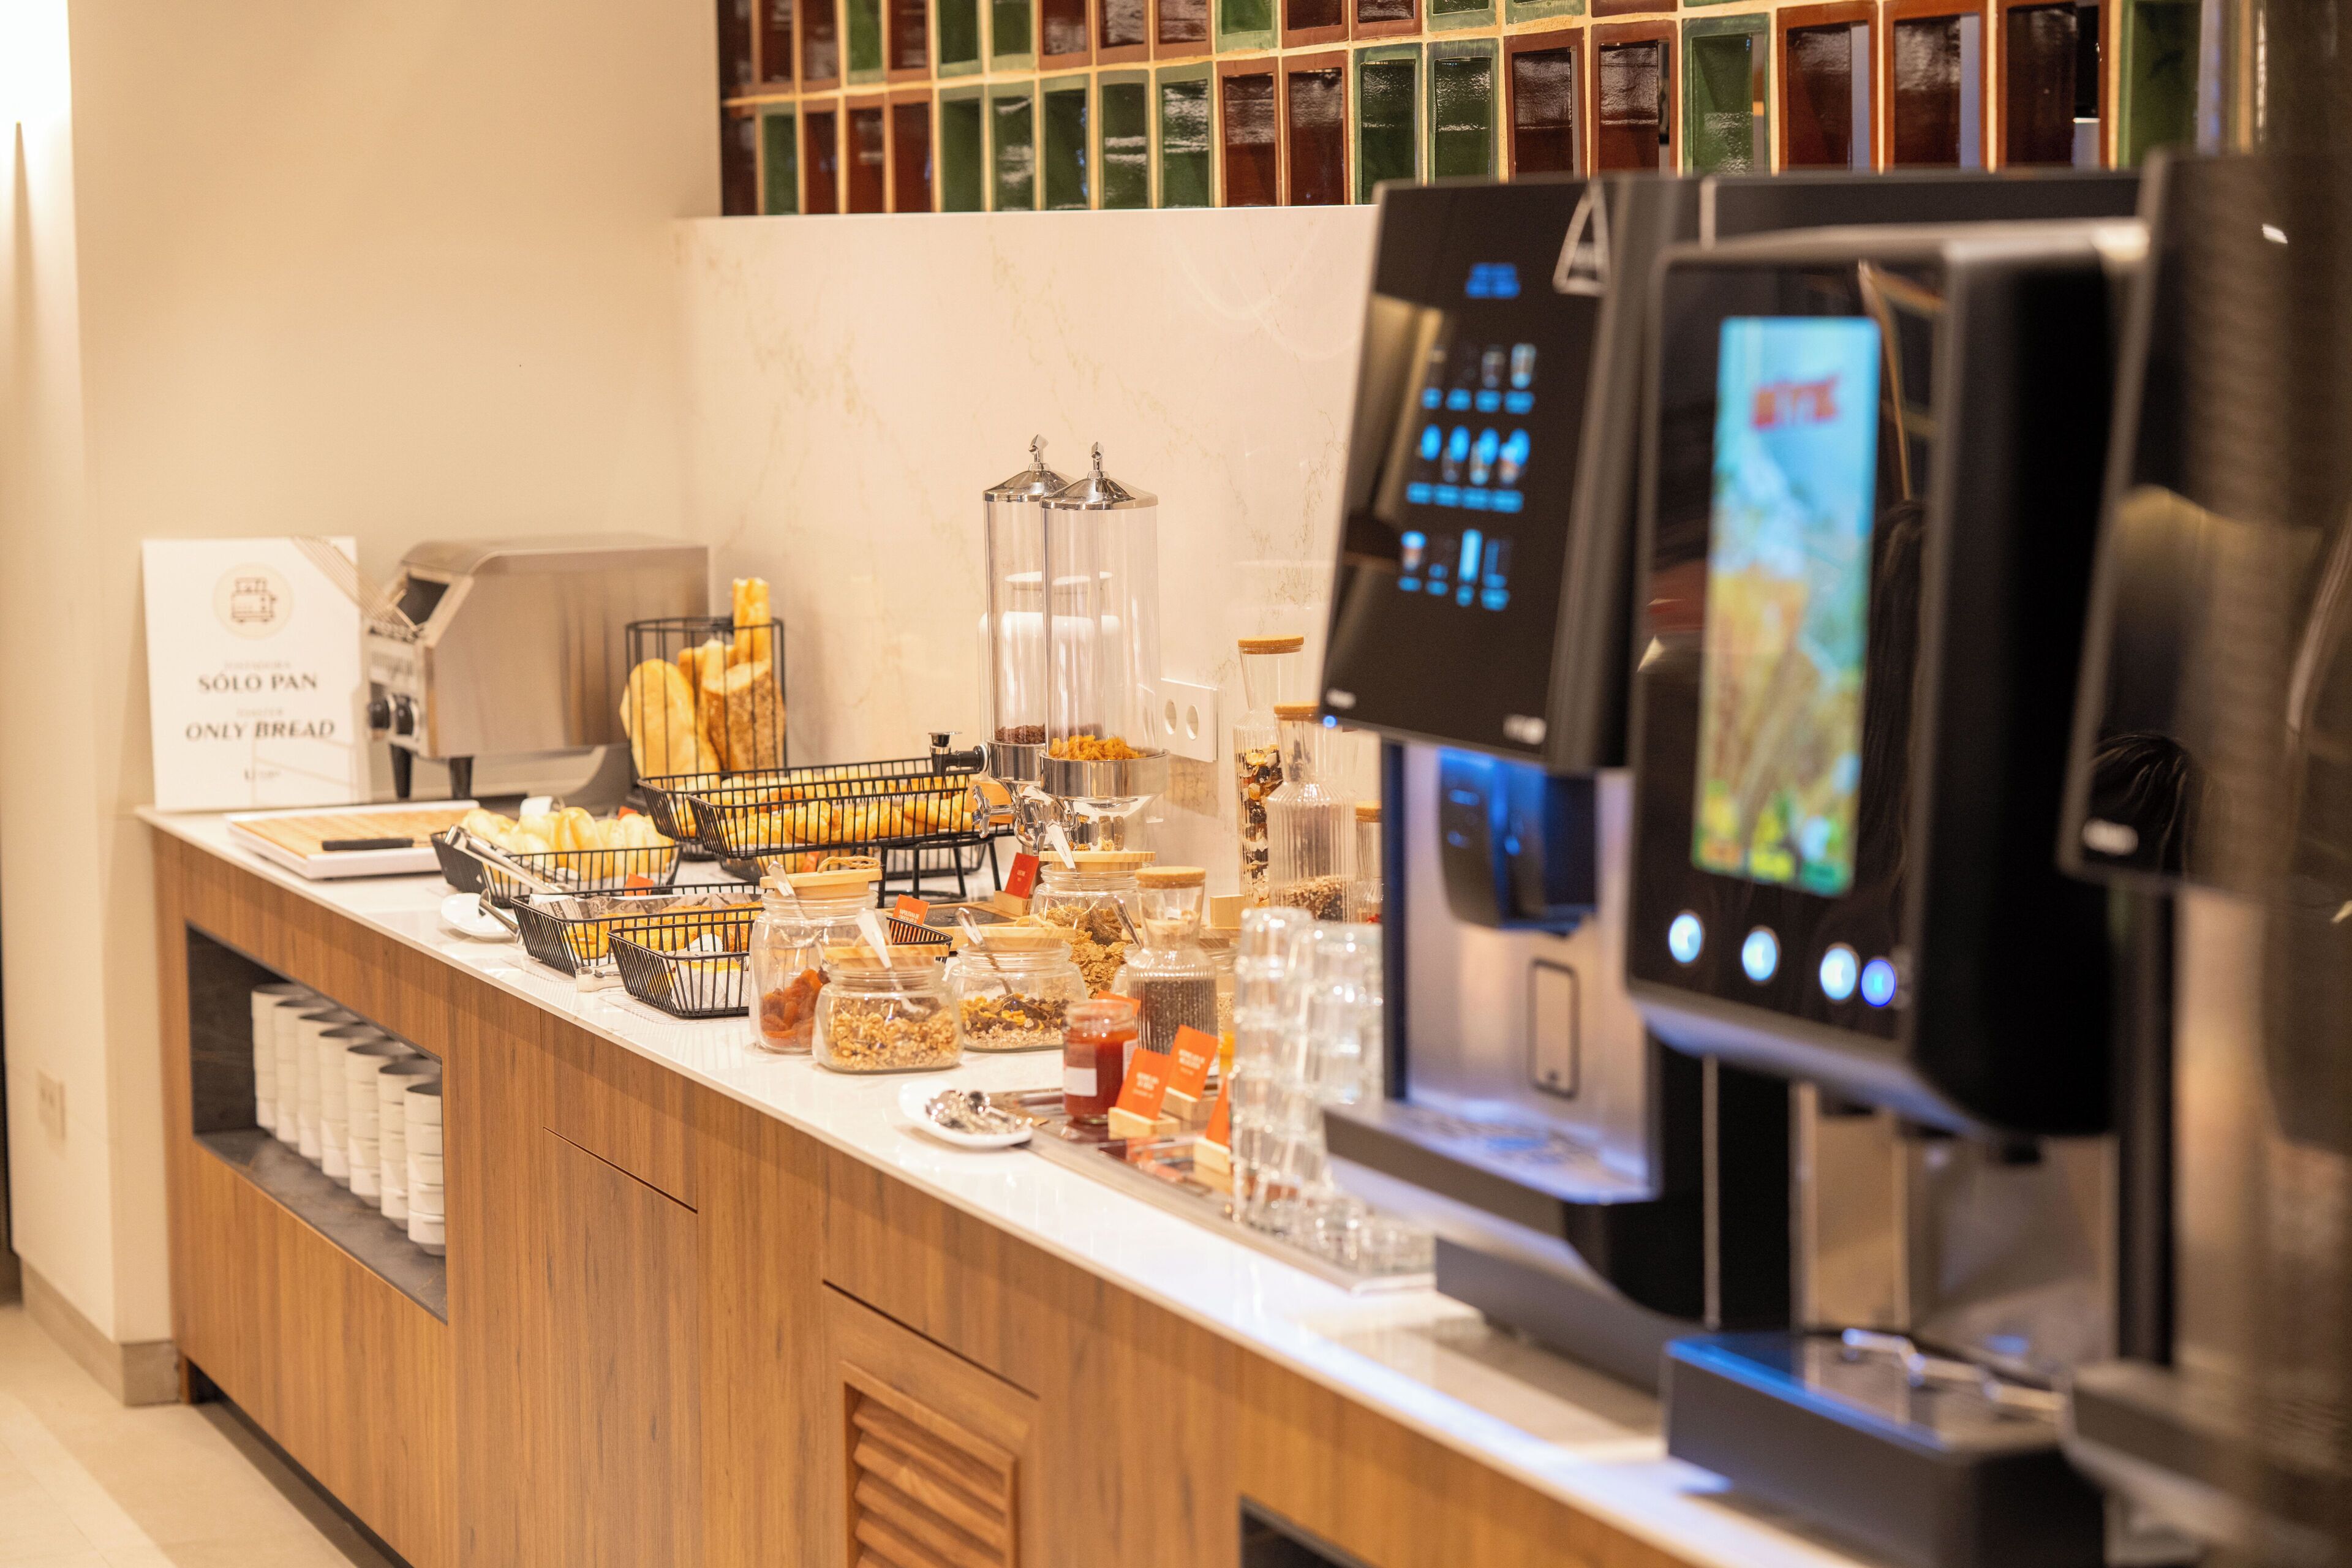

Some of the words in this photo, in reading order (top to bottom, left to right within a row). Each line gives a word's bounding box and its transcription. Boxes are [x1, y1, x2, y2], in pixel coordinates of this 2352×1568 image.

[198, 670, 262, 693] SÓLO
[270, 672, 317, 692] PAN
[185, 722, 247, 741] ONLY
[255, 719, 335, 739] BREAD
